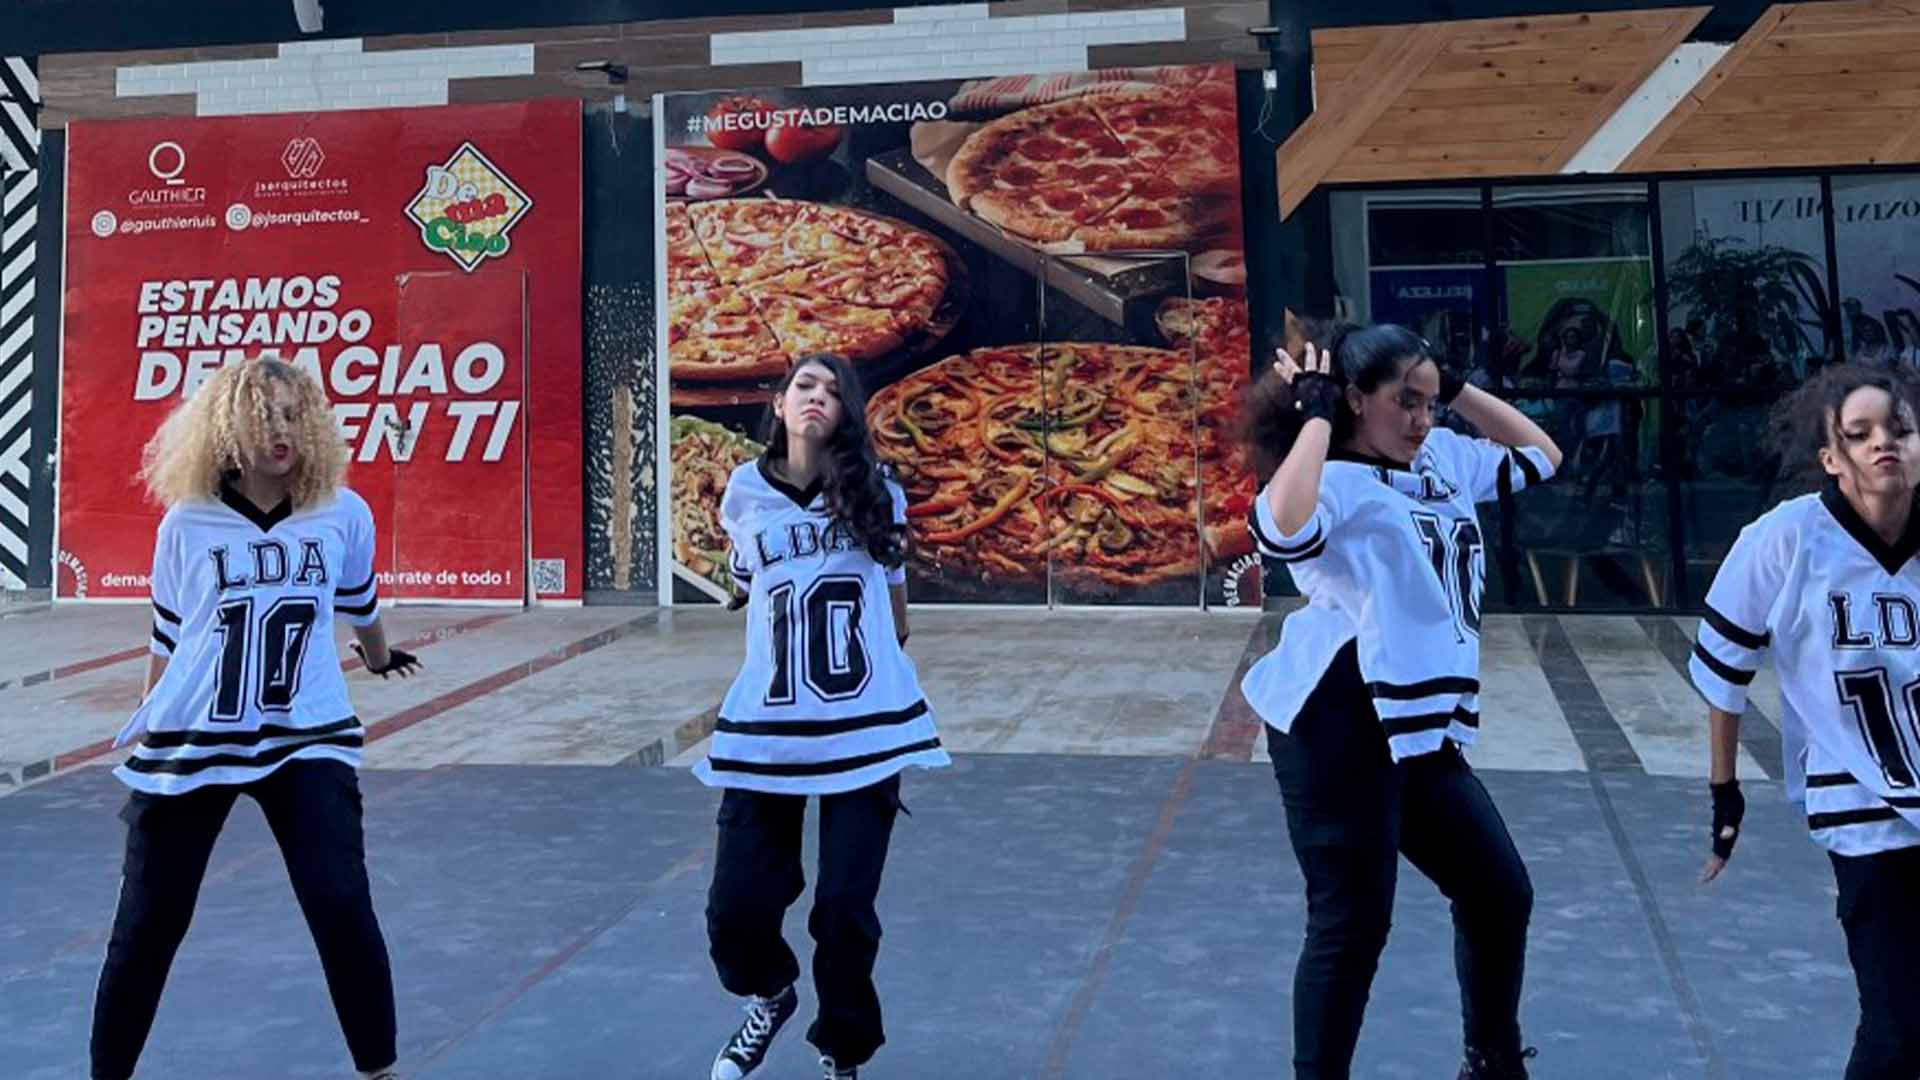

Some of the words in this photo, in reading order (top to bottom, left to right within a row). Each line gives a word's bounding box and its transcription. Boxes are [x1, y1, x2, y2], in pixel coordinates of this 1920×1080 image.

[687, 100, 948, 133] #MEGUSTADEMACIAO
[425, 168, 479, 200] De
[423, 216, 507, 252] Ciao
[137, 275, 341, 314] ESTAMOS
[136, 309, 372, 348] PENSANDO
[445, 401, 520, 462] TI
[208, 537, 329, 593] LDA
[436, 570, 458, 585] de
[461, 570, 502, 585] todo
[1223, 551, 1262, 608] DEMACIAO
[763, 573, 873, 706] 10
[208, 597, 319, 722] 10
